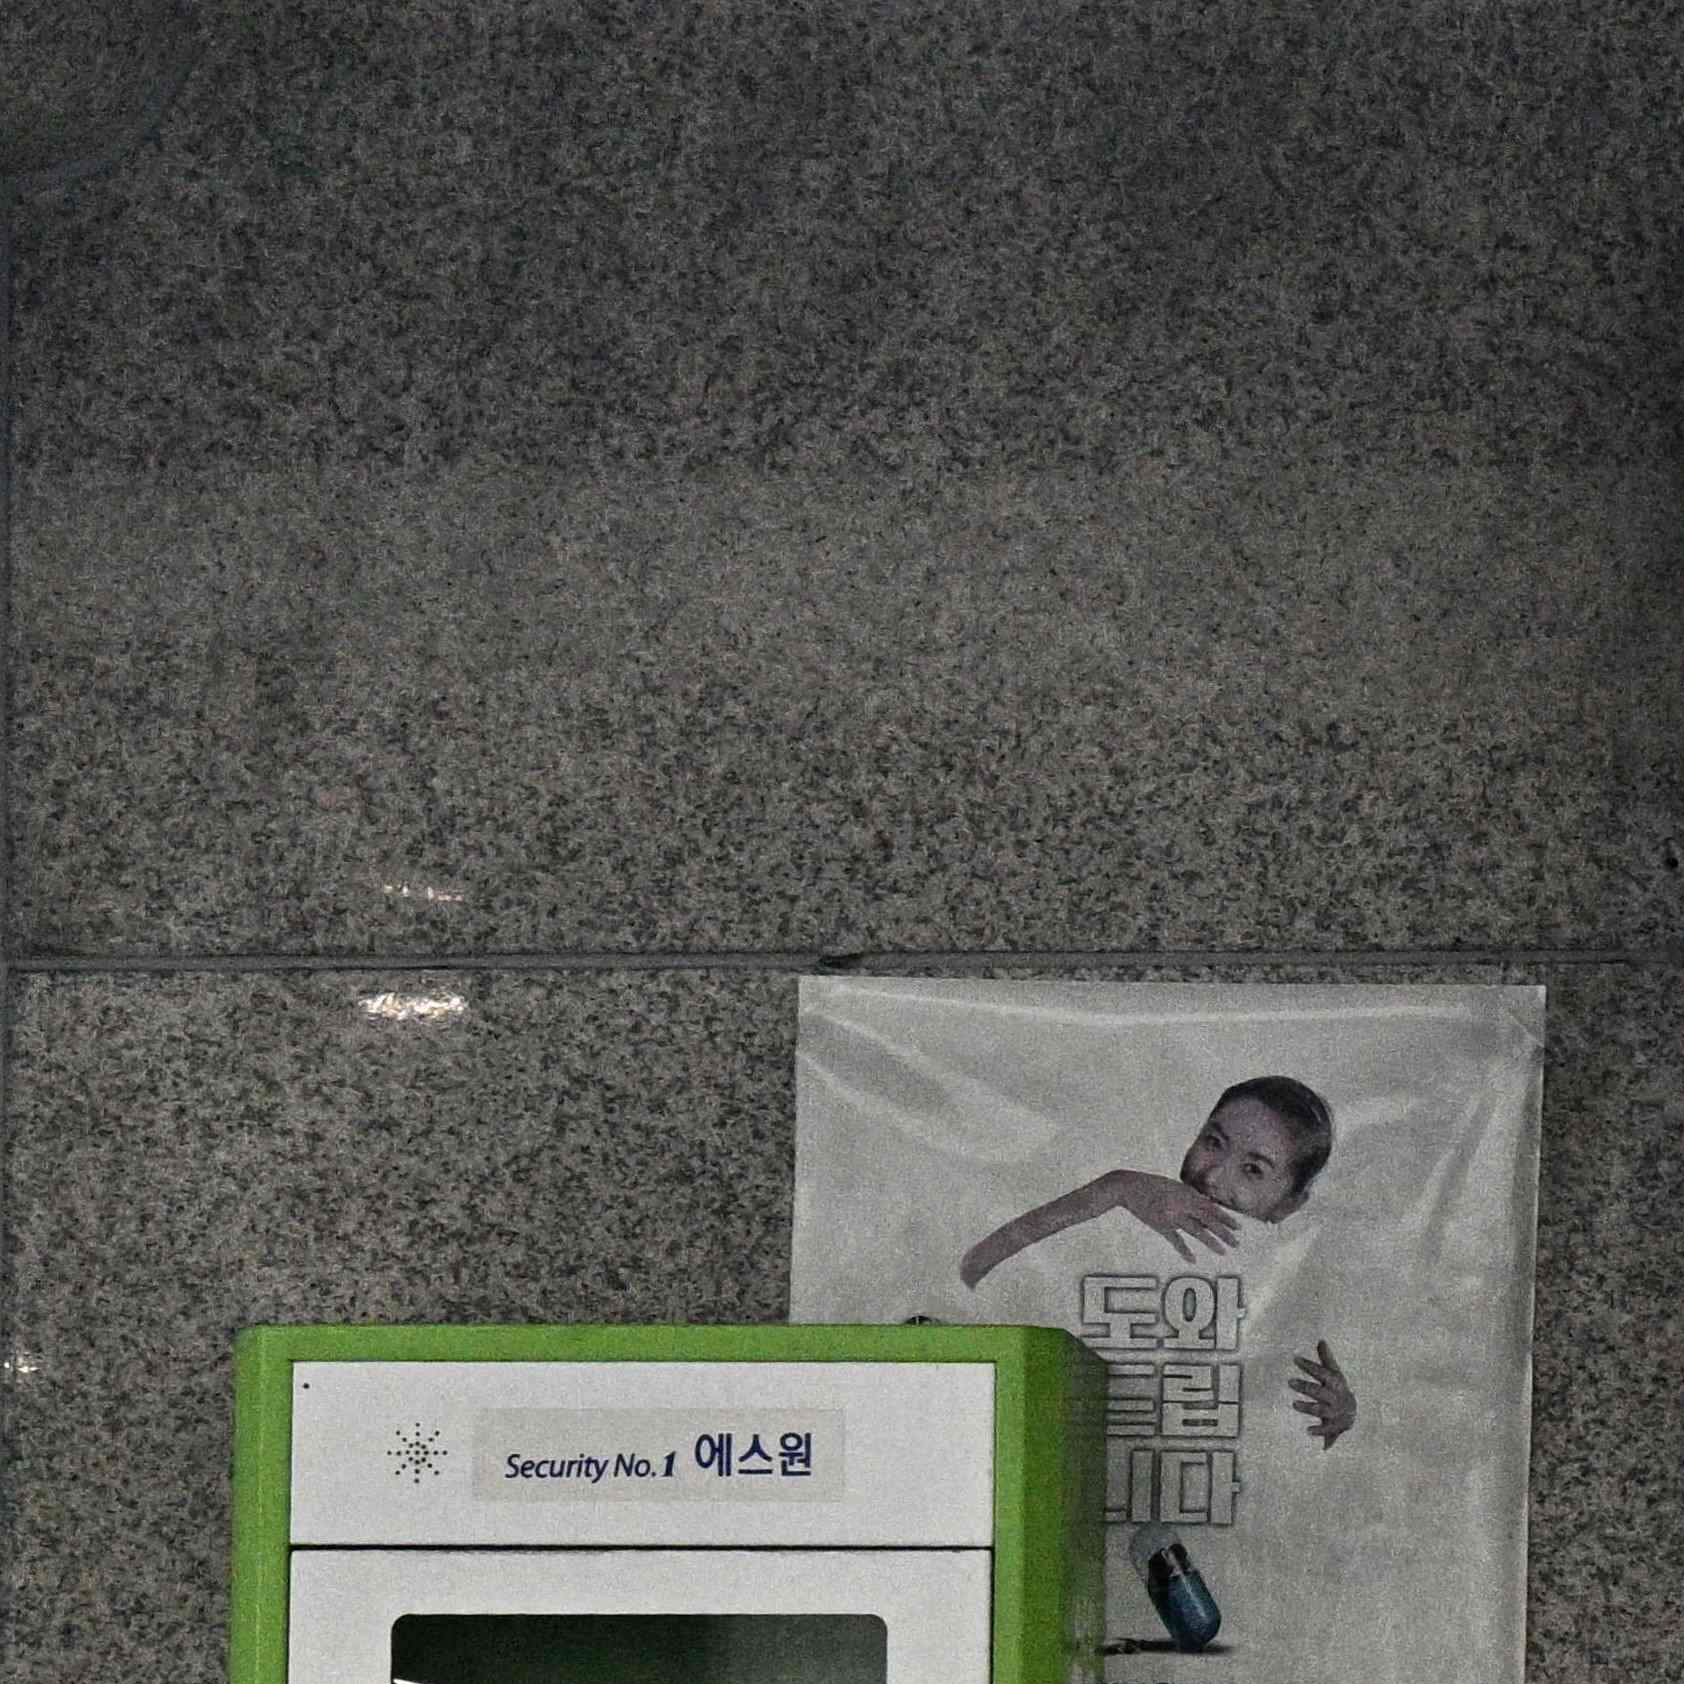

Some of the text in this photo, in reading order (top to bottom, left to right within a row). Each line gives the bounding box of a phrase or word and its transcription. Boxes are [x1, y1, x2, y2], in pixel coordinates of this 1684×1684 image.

[1081, 1274, 1247, 1350] 도와
[505, 1431, 813, 1484] Security No.1 에스원
